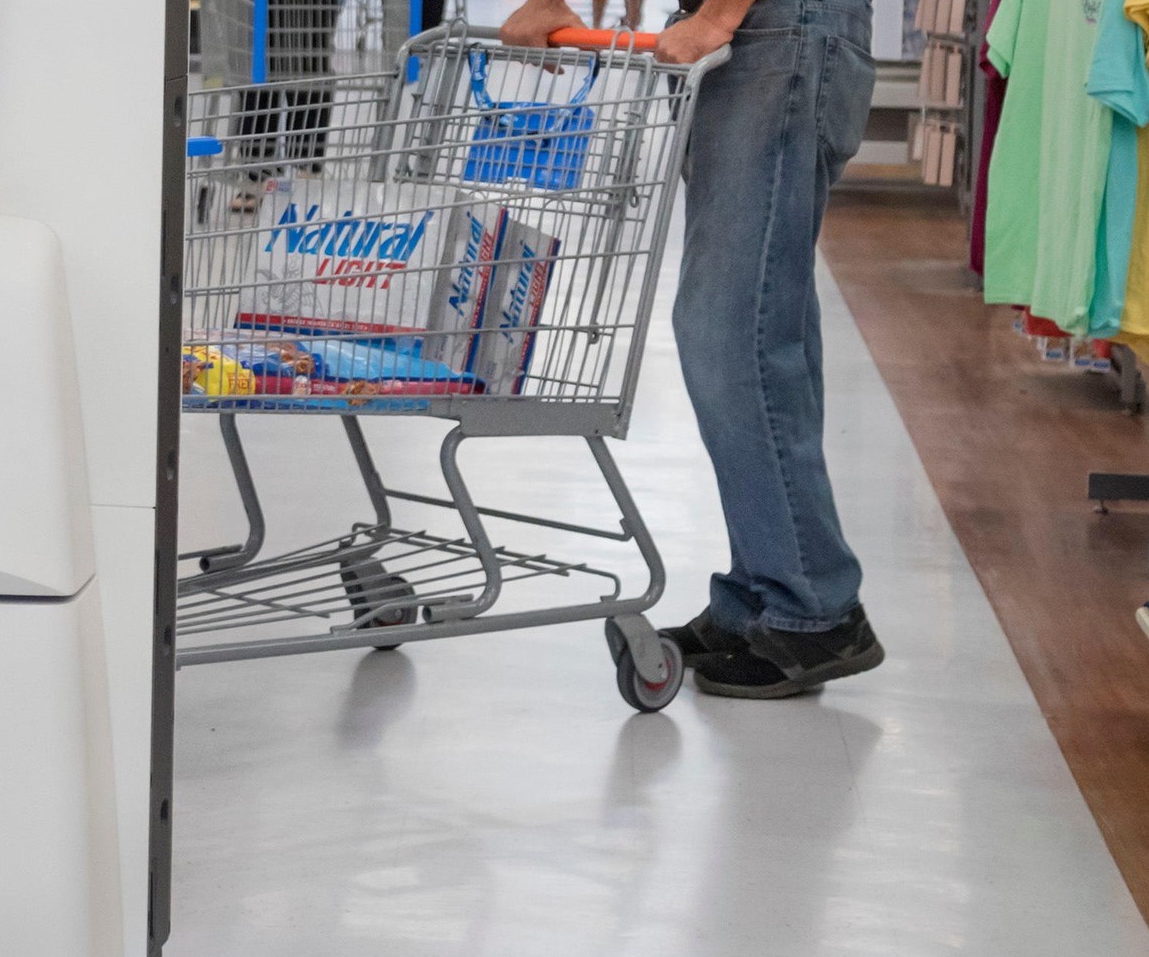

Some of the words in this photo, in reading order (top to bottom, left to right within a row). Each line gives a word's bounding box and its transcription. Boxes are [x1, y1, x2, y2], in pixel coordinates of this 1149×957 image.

[265, 203, 435, 262] Natural
[311, 258, 408, 290] LIGHT
[448, 211, 484, 318] Natural
